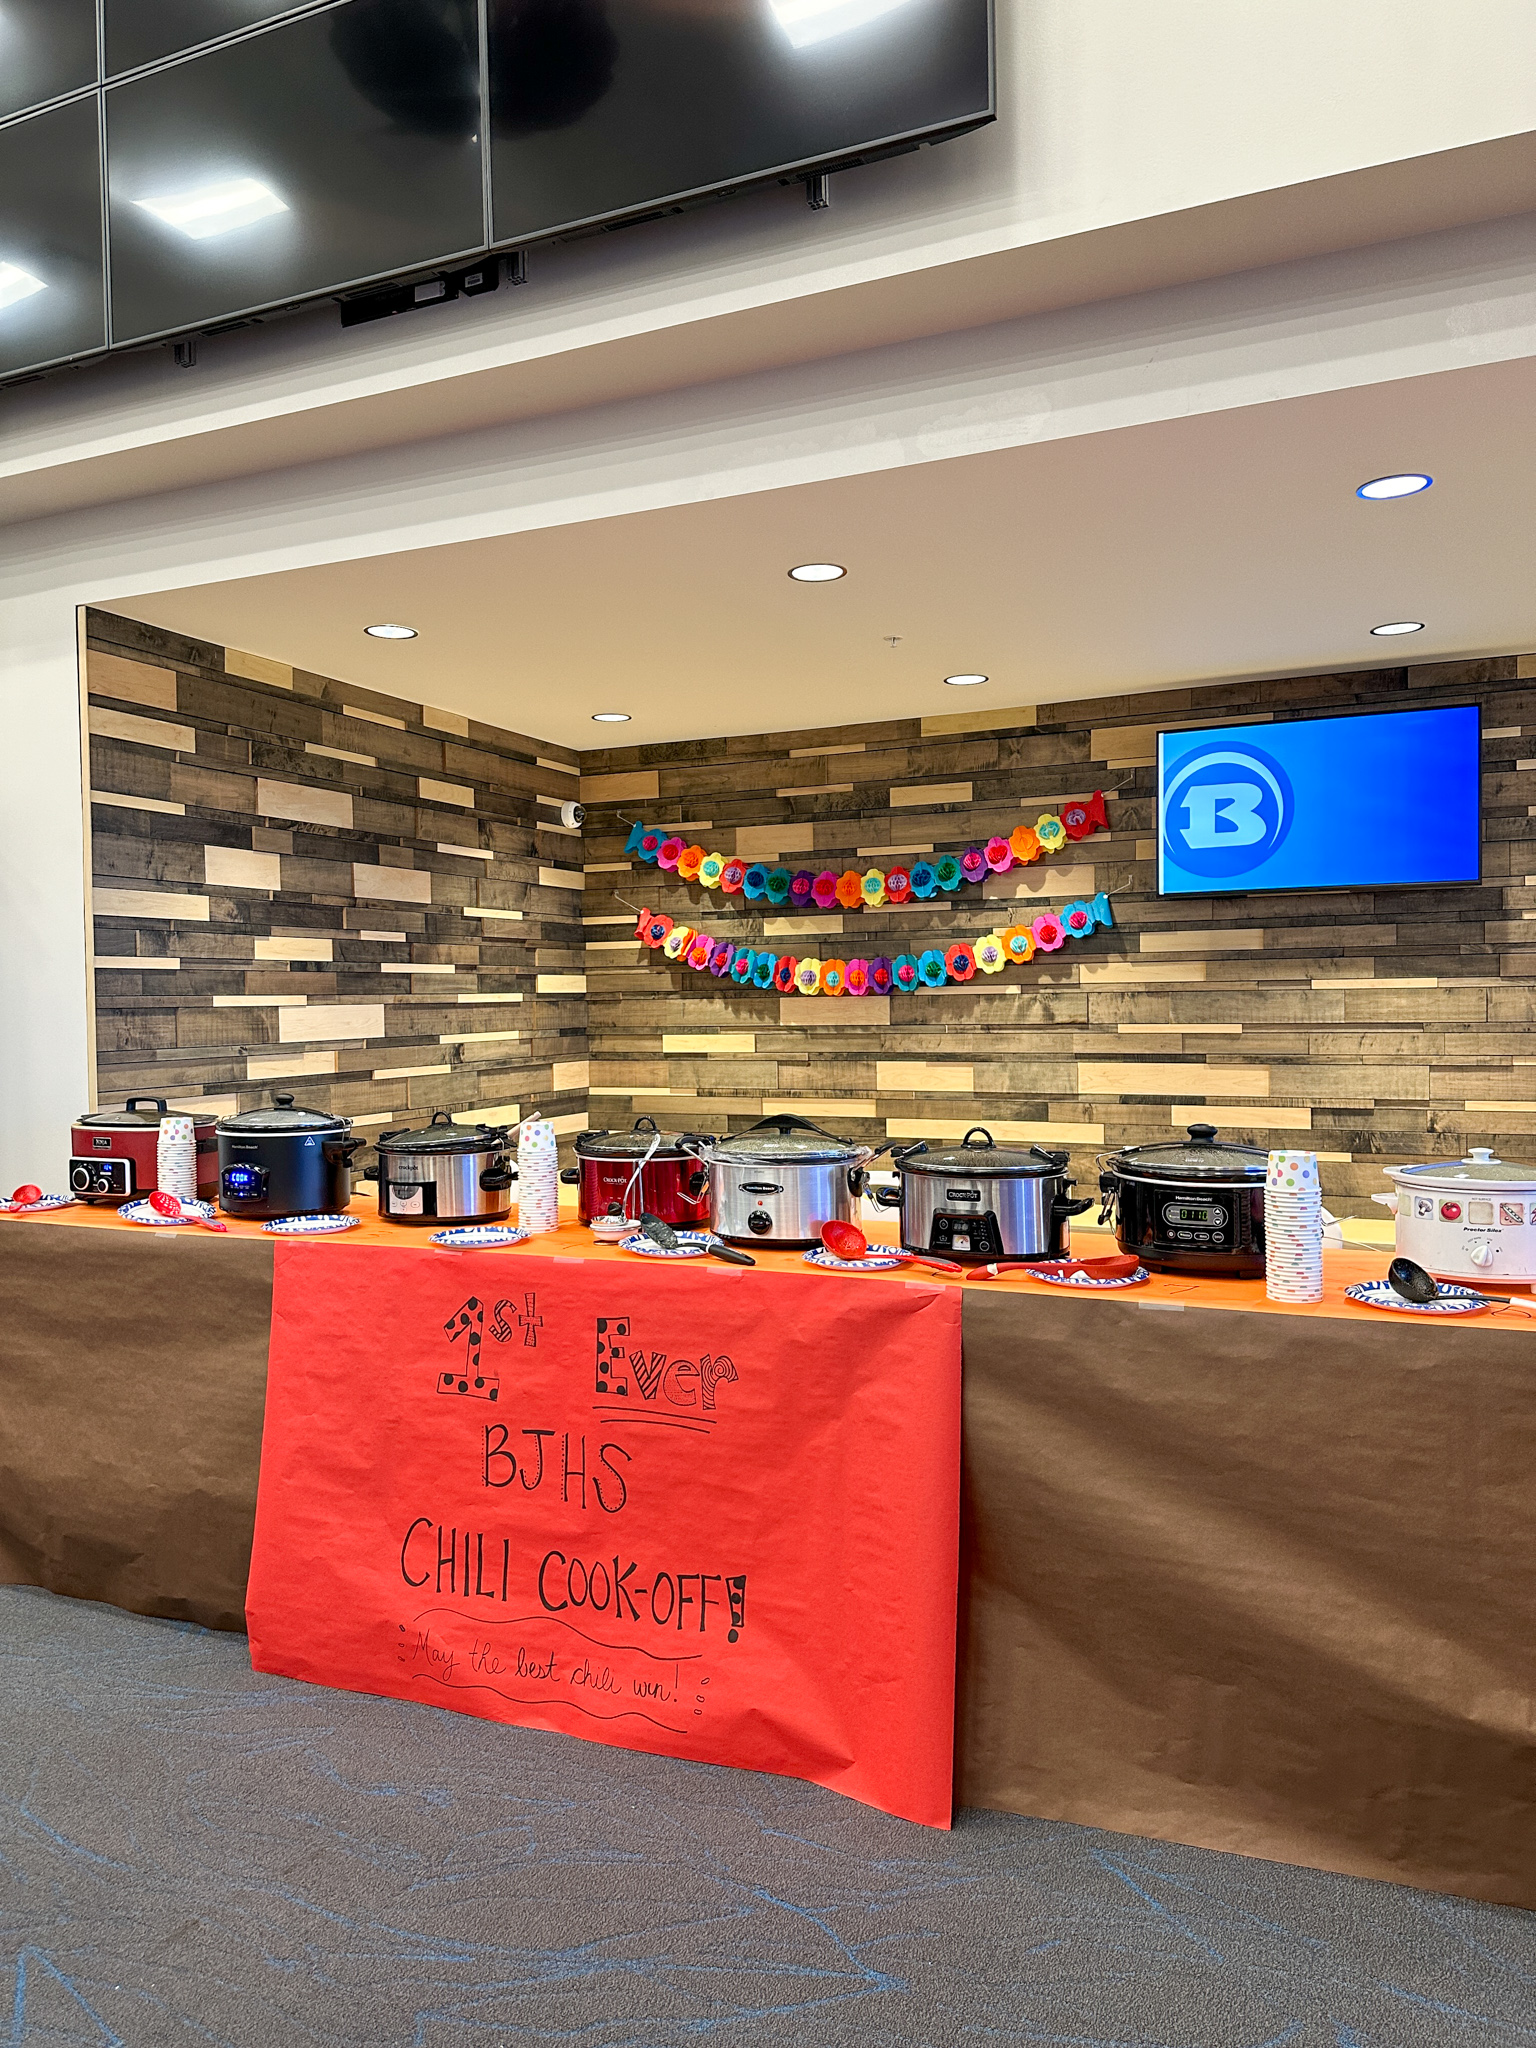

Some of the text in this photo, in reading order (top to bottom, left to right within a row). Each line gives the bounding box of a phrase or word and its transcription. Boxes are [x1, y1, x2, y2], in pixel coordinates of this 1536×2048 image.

[1179, 782, 1267, 849] B
[437, 1292, 739, 1410] 1st Ever
[481, 1423, 632, 1513] BJHS
[401, 1517, 747, 1644] CHILI COOK-OFF!
[412, 1628, 681, 1703] May the best chili win!
